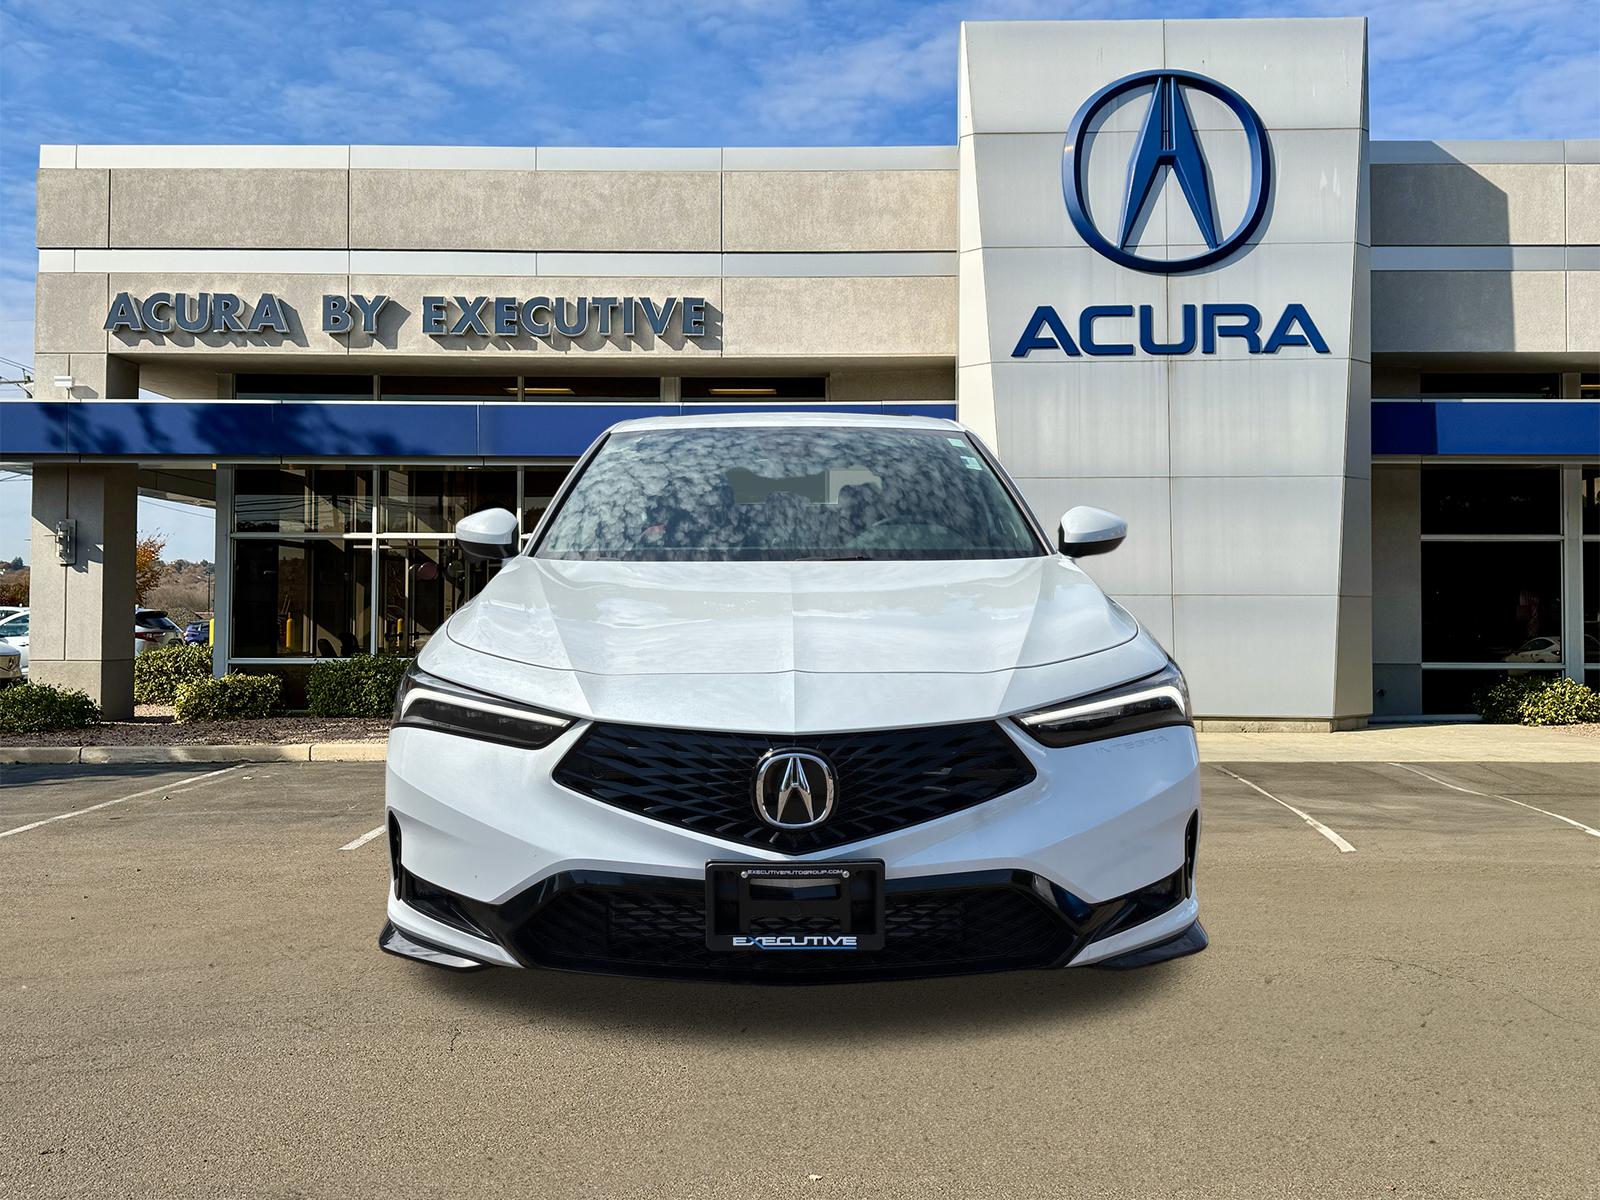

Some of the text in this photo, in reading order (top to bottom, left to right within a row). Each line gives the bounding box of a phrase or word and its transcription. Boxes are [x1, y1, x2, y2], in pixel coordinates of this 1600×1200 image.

[104, 291, 707, 337] ACURA BY EXECUTIVE
[1010, 303, 1332, 358] ACURA
[732, 936, 858, 948] EXECUTIVE
